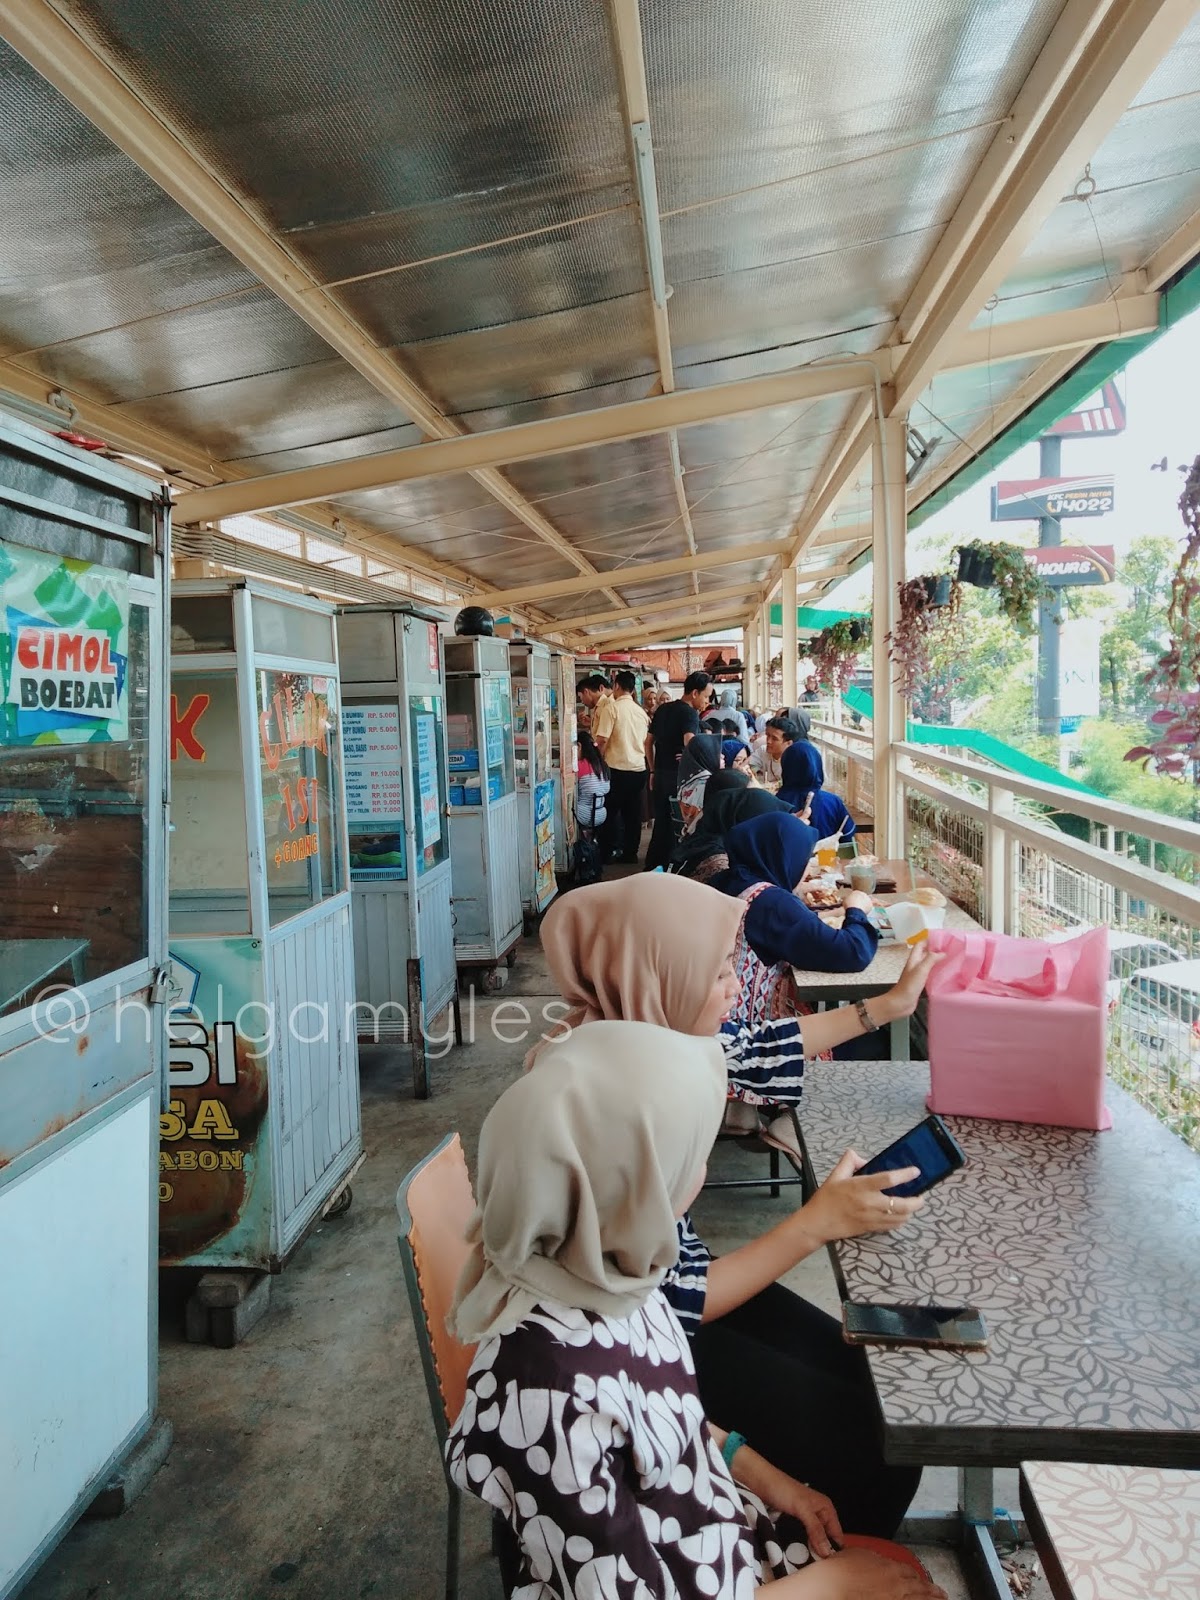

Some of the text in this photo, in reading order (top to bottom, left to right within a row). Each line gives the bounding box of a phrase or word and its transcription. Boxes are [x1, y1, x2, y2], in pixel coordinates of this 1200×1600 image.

[1056, 497, 1112, 513] 14022
[1037, 561, 1091, 576] HOURS
[17, 628, 116, 675] CIMOL
[20, 677, 115, 710] BOEBAT
[282, 777, 319, 832] ISI
